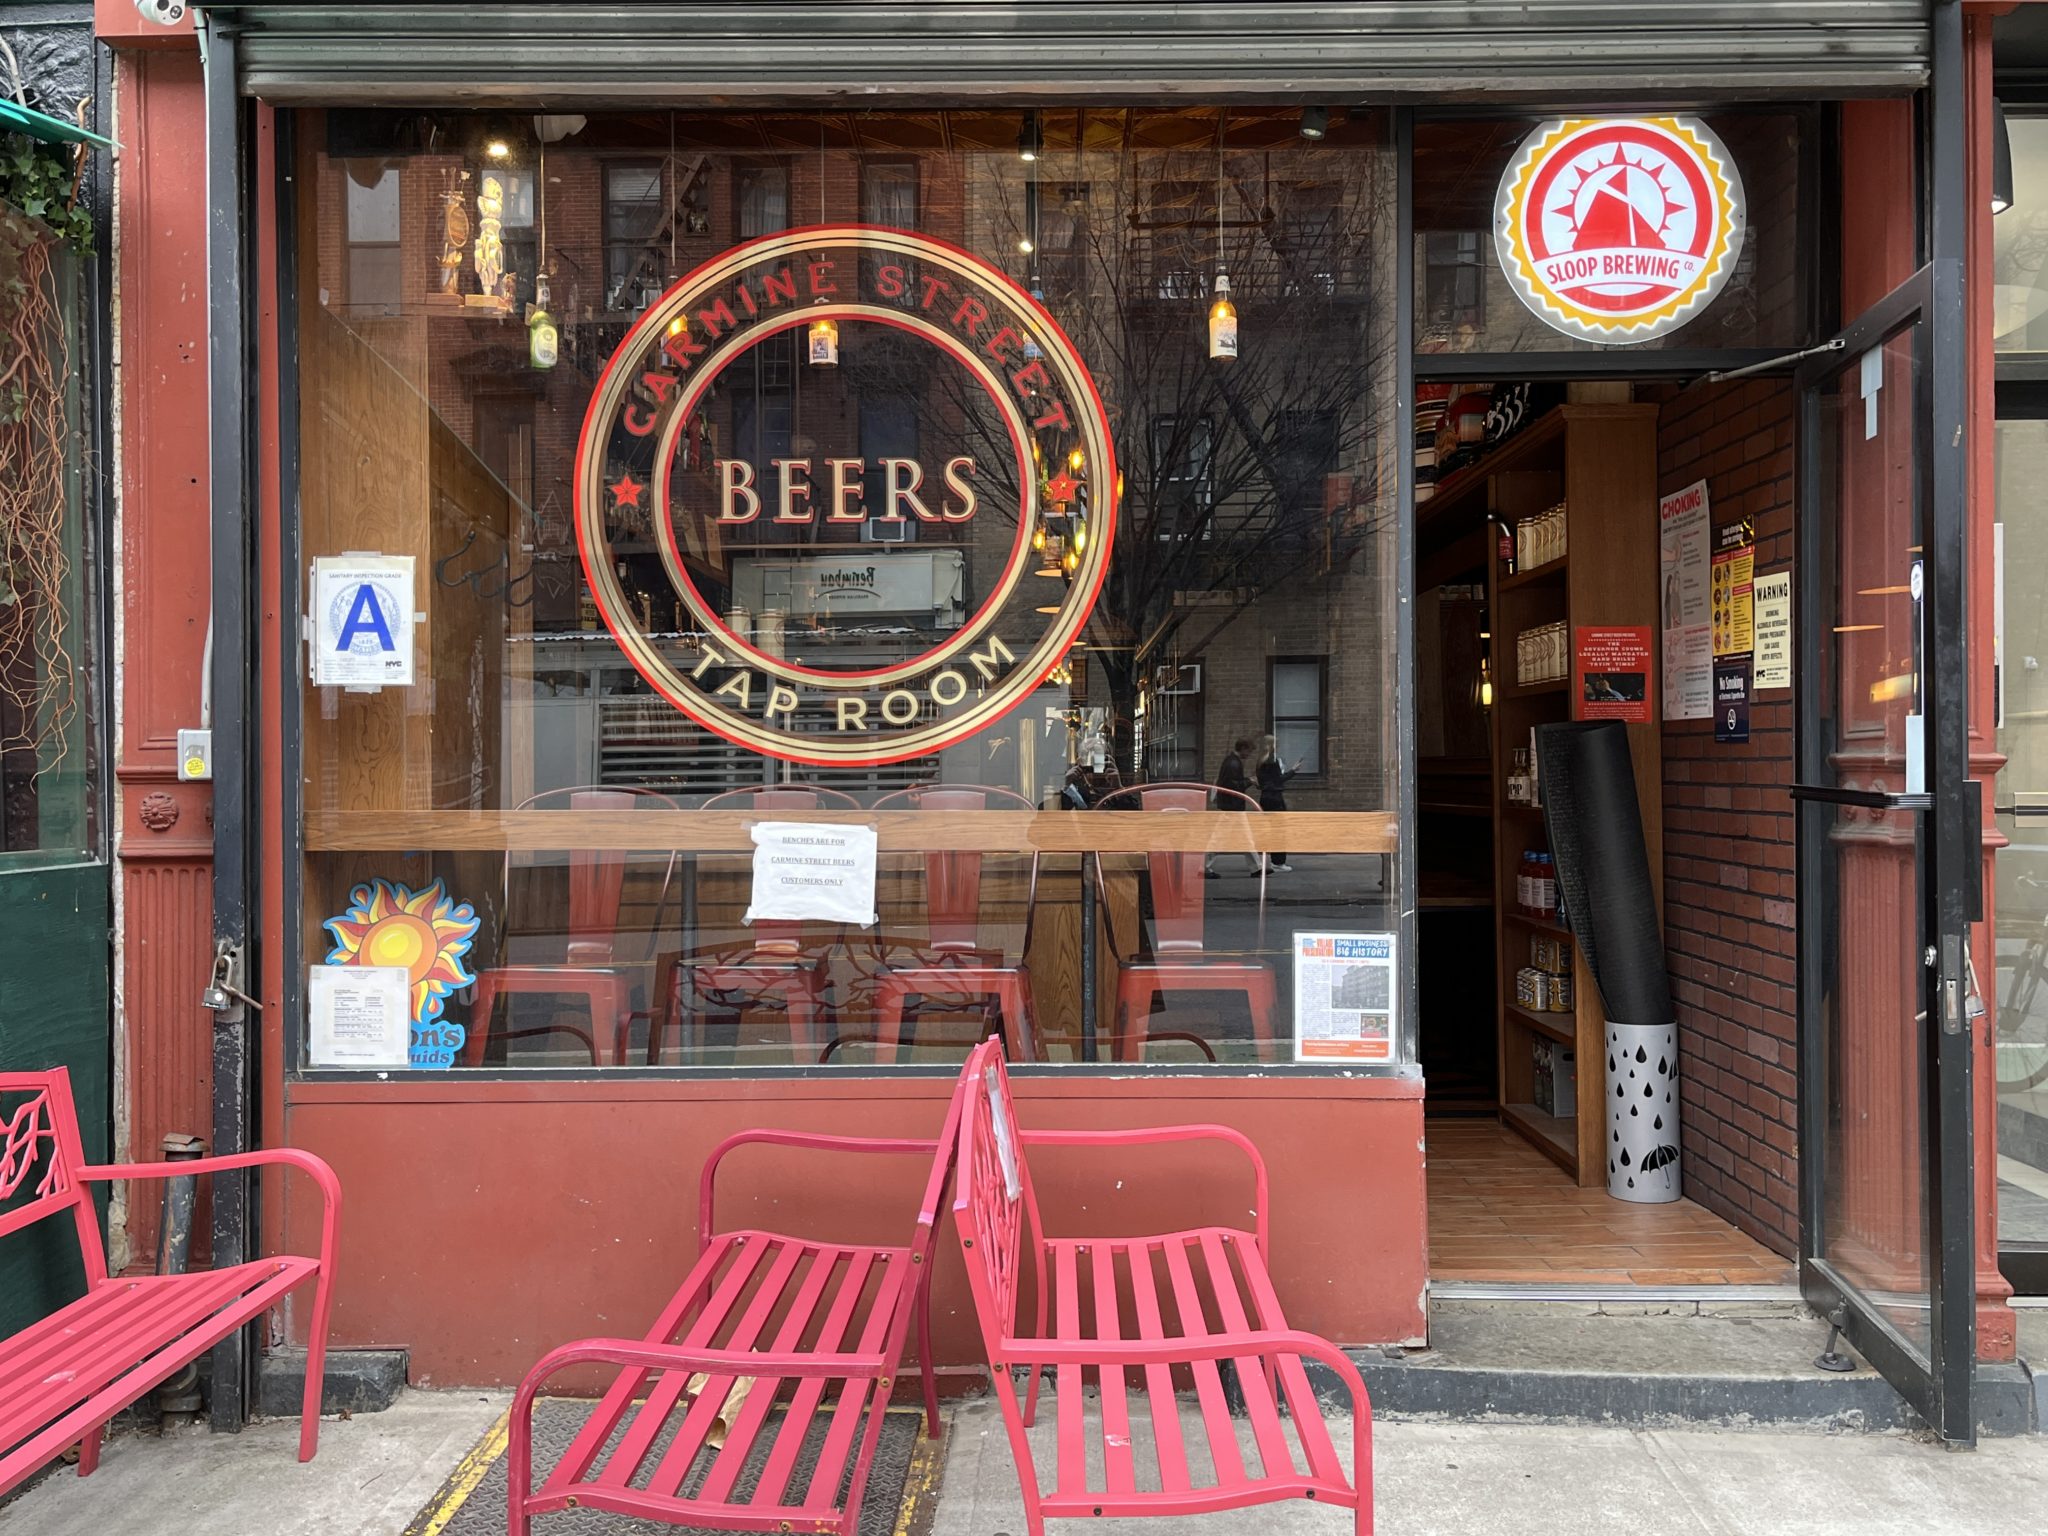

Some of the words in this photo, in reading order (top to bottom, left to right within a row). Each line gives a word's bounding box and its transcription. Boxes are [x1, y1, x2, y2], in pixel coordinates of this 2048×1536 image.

[1546, 256, 1598, 285] SLOOP
[1603, 254, 1680, 280] BREWING
[1683, 260, 1695, 272] CO.
[624, 261, 837, 438] CARMINE
[877, 264, 1070, 433] STREET
[715, 456, 979, 525] BEERS
[1661, 489, 1702, 520] CHOKING
[1756, 582, 1788, 603] WARNING
[335, 584, 396, 651] A
[690, 643, 798, 719] TAP
[836, 634, 1016, 730] ROOM
[782, 836, 814, 845] BENCHES
[815, 837, 830, 846] ARE
[831, 838, 846, 847] FOR
[771, 856, 803, 865] CARMINE
[804, 857, 832, 866] STREET
[832, 858, 856, 866] BEERS
[781, 876, 824, 886] CUSTOMERS
[824, 878, 844, 887] ONLY
[1336, 947, 1350, 956] BIG
[1352, 947, 1387, 957] HISTORY
